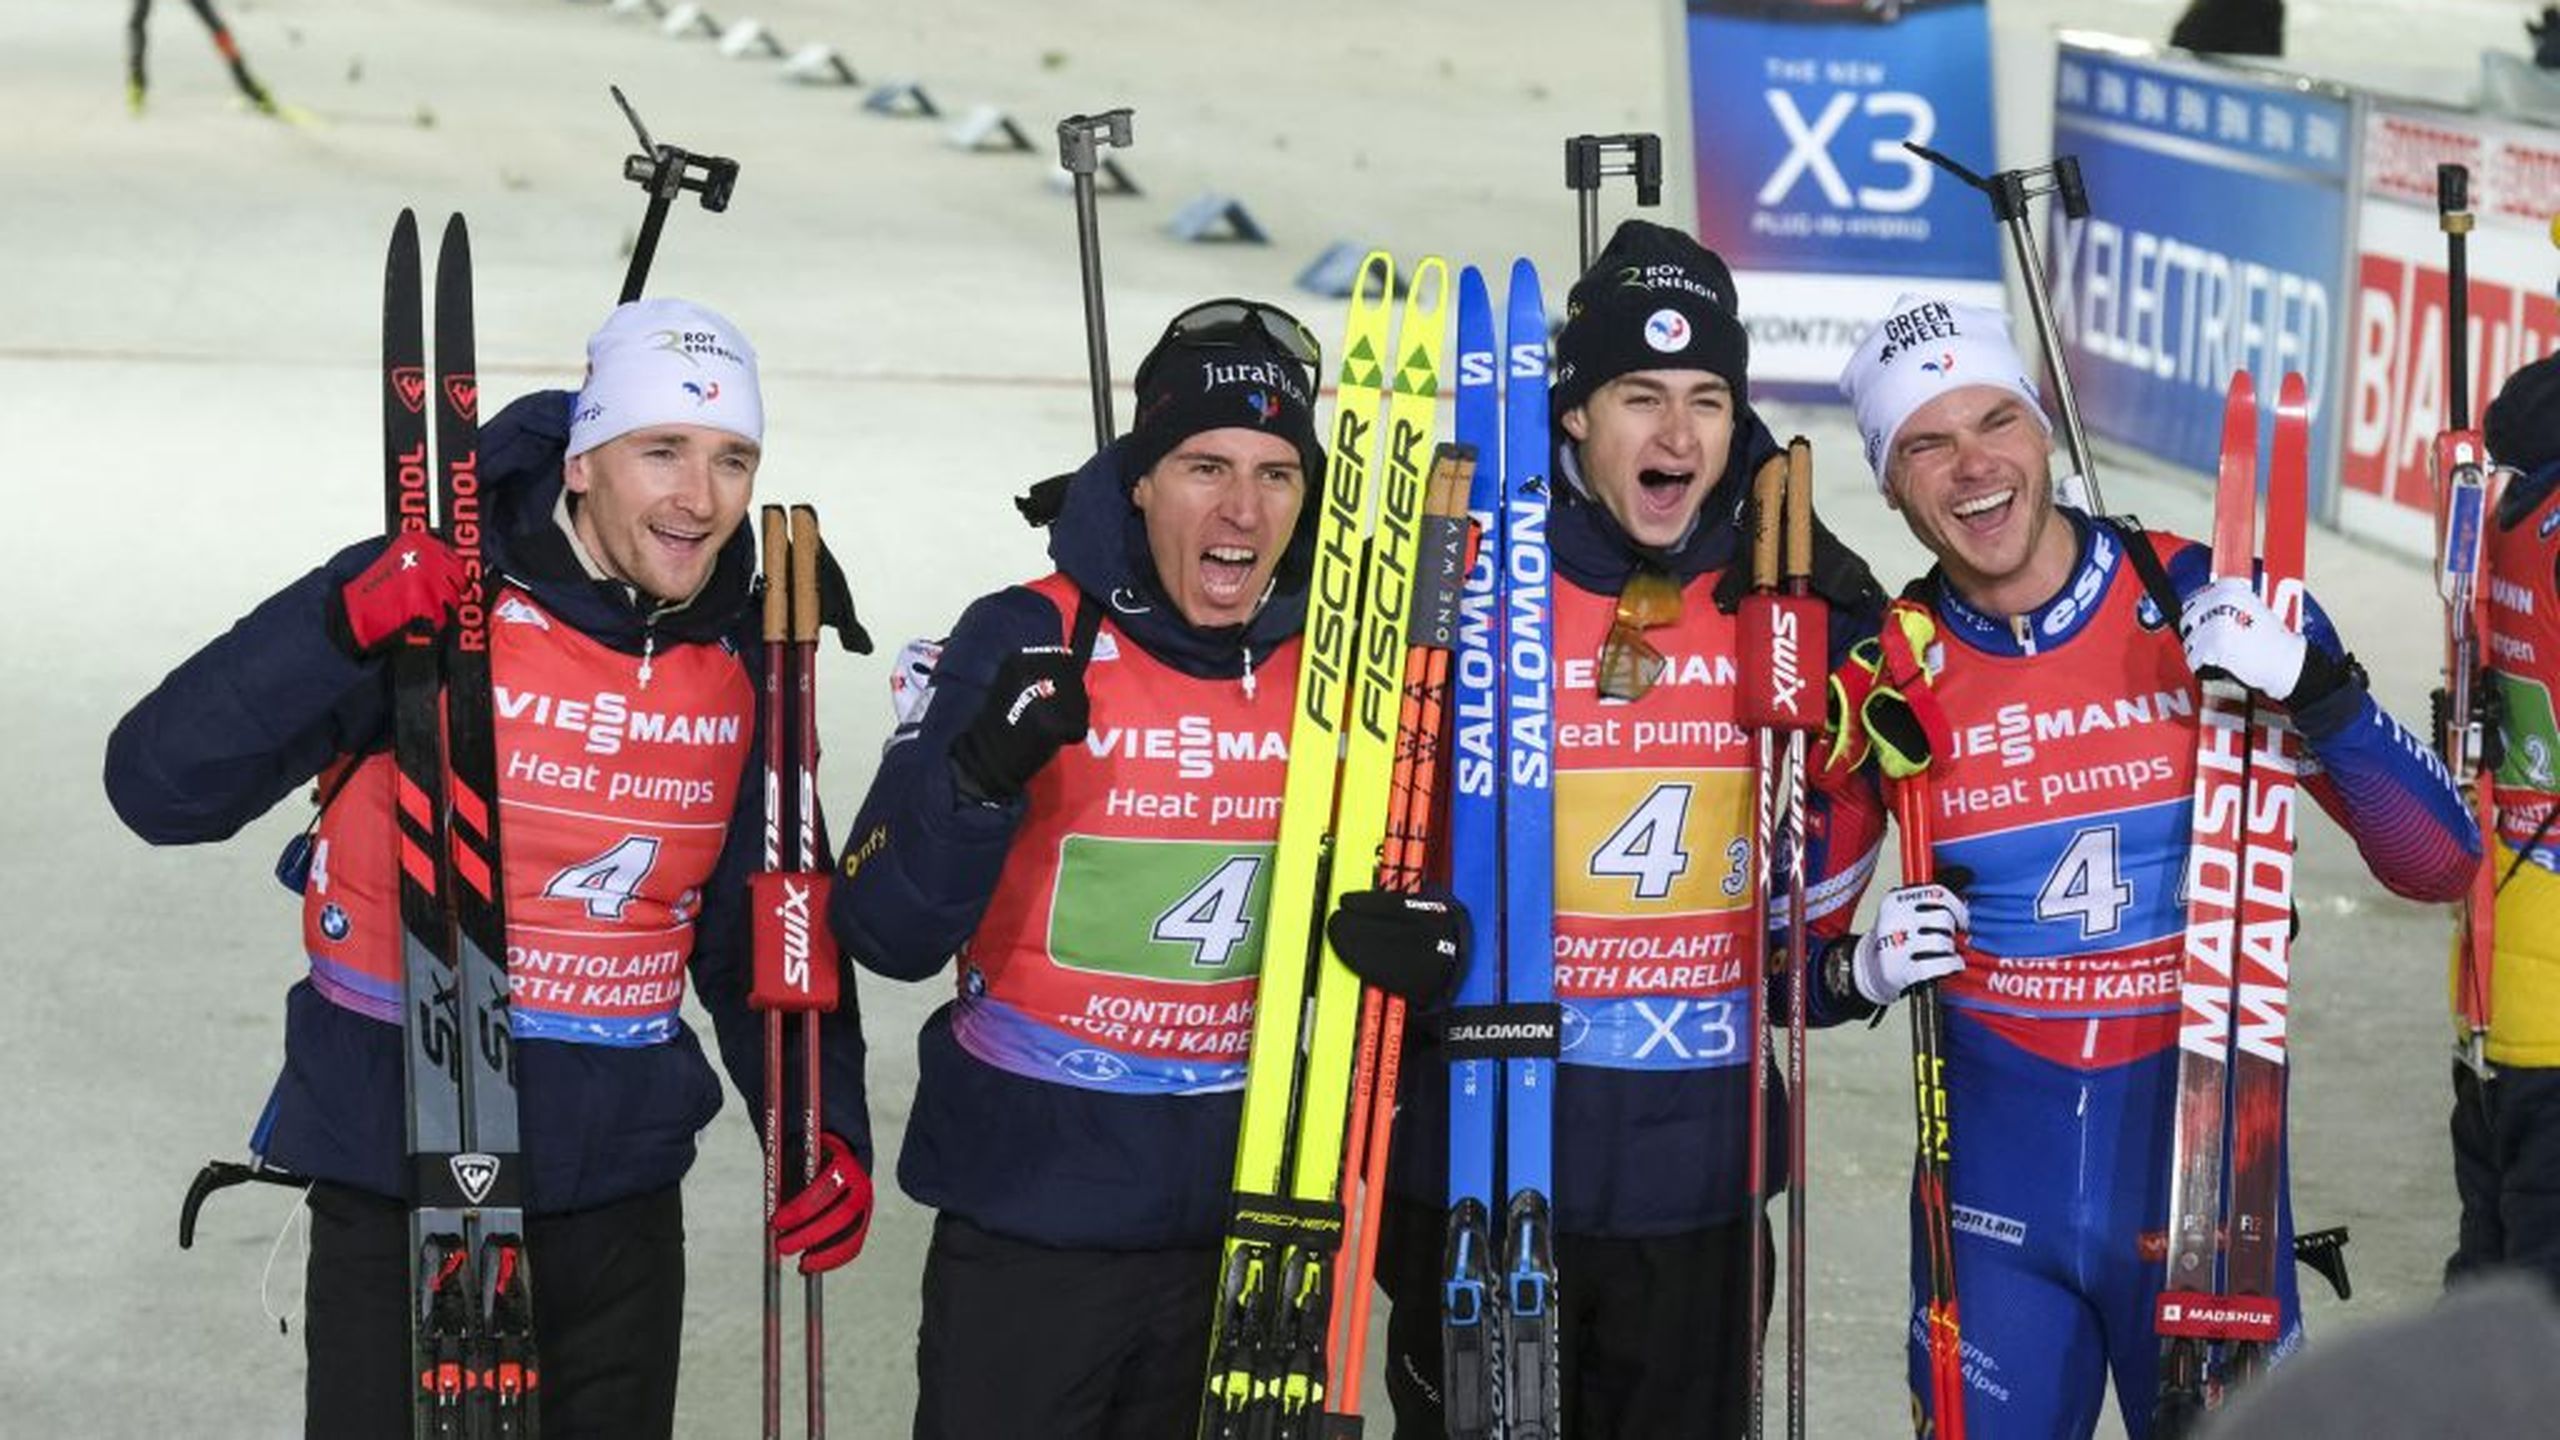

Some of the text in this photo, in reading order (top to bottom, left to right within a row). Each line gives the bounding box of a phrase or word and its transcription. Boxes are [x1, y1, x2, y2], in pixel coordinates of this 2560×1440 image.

[1764, 58, 1885, 86] THE NEW
[1757, 87, 1937, 212] X3
[1646, 263, 1686, 279] ROY
[683, 331, 717, 344] ROY
[1884, 301, 1953, 342] GREEN
[1899, 321, 1962, 352] WEEZ
[454, 450, 485, 652] ROSSIGNOL
[1305, 408, 1371, 734] FISCHER
[1361, 418, 1424, 744] FISCHER
[1436, 521, 1458, 642] ONE WAY
[1512, 502, 1547, 790] SALOMON
[494, 686, 740, 755] VIESSMANN
[1086, 716, 1290, 779] VIESSMA
[1558, 719, 1749, 753] eat pumps
[1949, 687, 2193, 768] IESSMANN
[507, 751, 715, 810] Heat pumps
[1941, 755, 2175, 818] Heat pumps
[2524, 734, 2556, 787] 2
[1106, 789, 1285, 826] Heat pum
[310, 839, 330, 895] 4
[1586, 780, 1751, 901] 4 3
[540, 833, 662, 923] 4
[2034, 823, 2135, 942] 4
[2178, 704, 2246, 1062] MADSH
[1150, 854, 1261, 968] 4
[507, 945, 679, 979] ONTIOLAHTI
[1554, 932, 1735, 959] ONTIOLAHTI
[509, 974, 576, 1004] RTH
[1554, 959, 1742, 989] RTH KARELIA
[1988, 971, 2086, 1002] NORTH
[1086, 994, 1254, 1027] KONTIOLAH
[1449, 1023, 1554, 1041] SALOMON
[1631, 999, 1737, 1060] X3
[1176, 1030, 1253, 1054] KARE
[1236, 1210, 1341, 1233] FISCHER
[2187, 1308, 2273, 1325] MADSHUS
